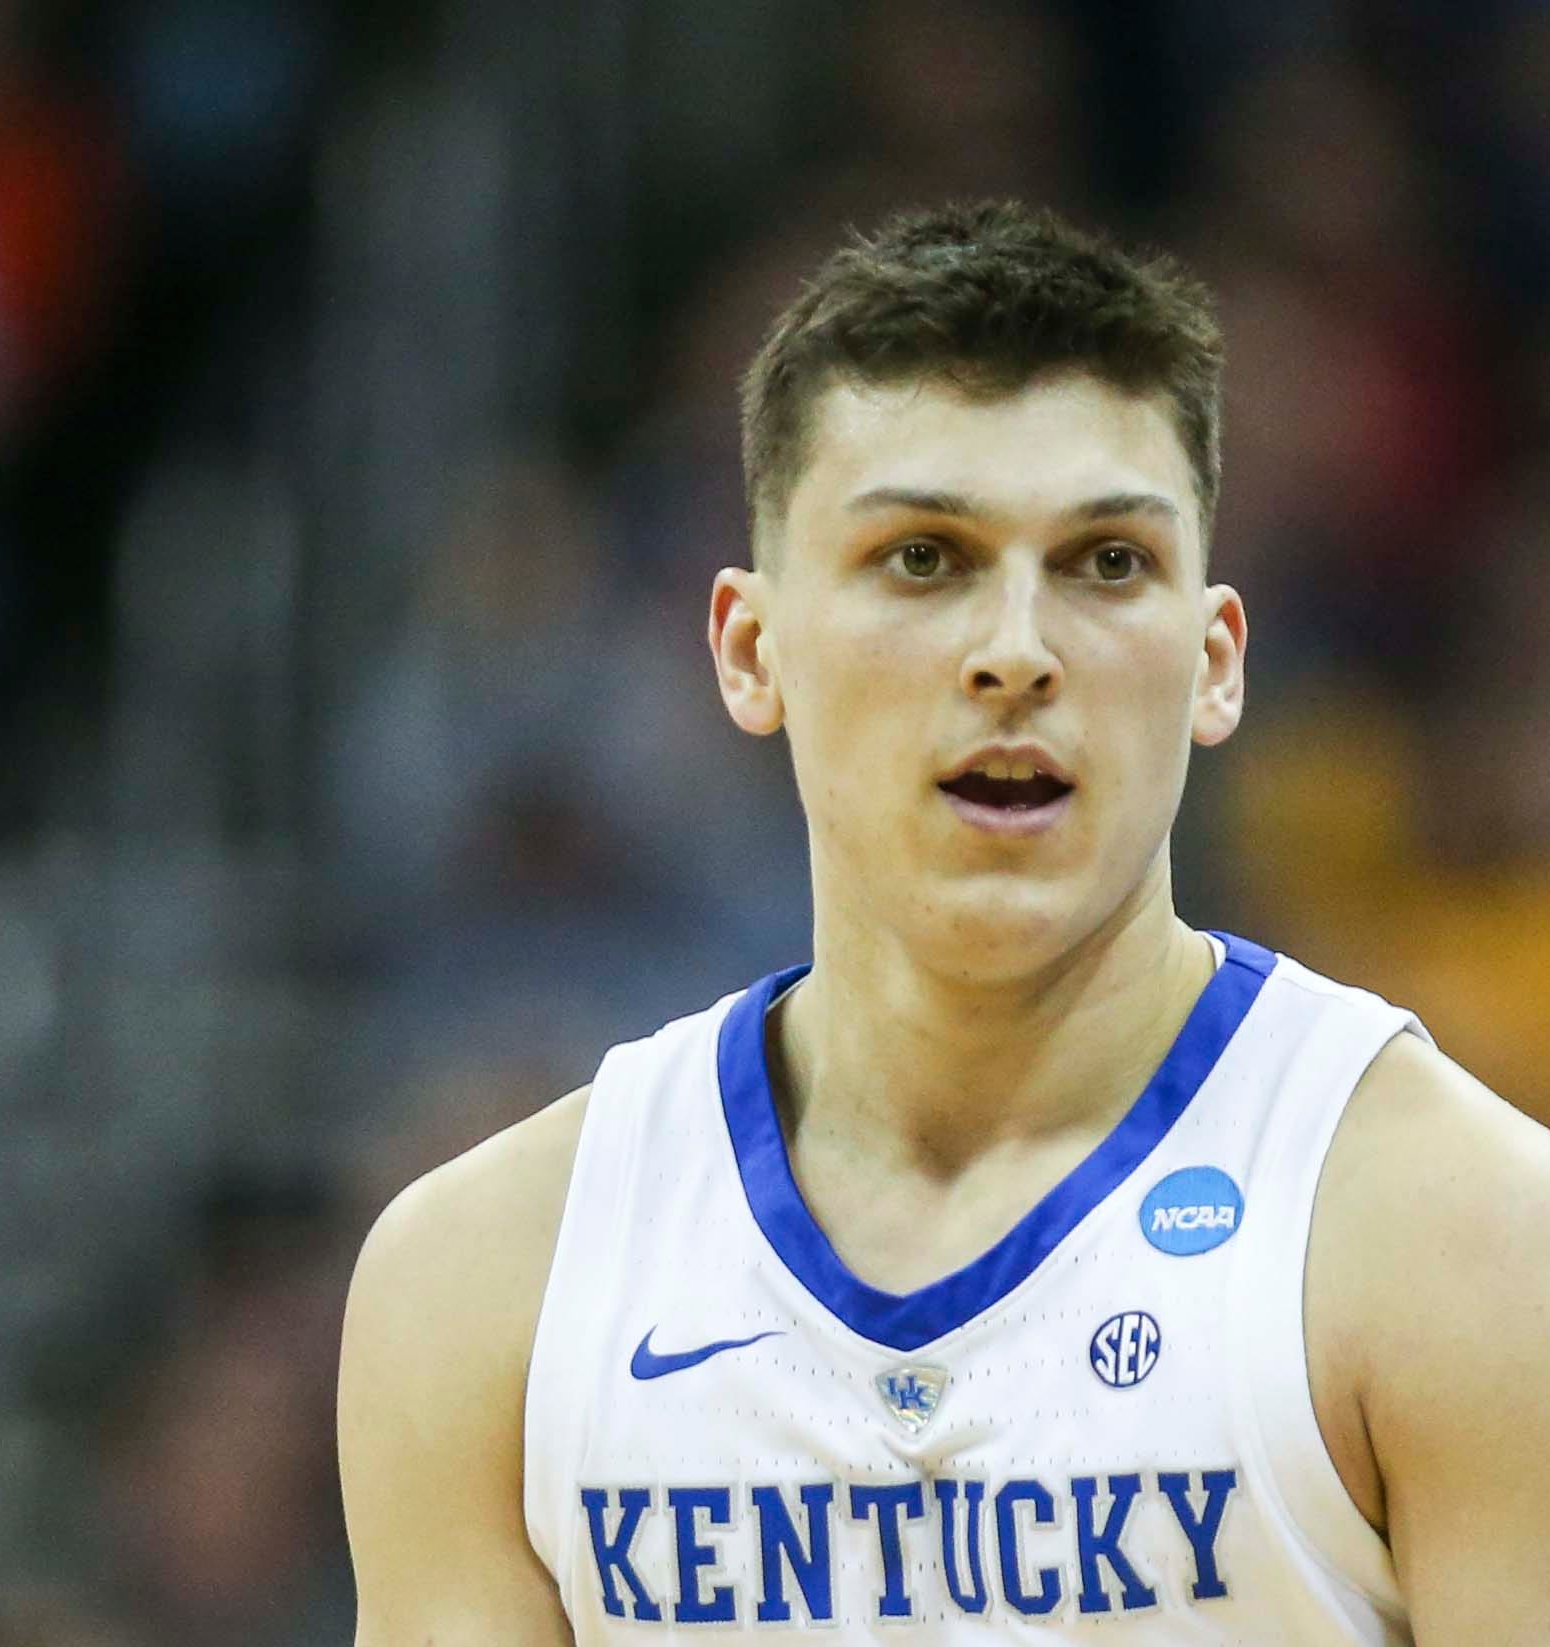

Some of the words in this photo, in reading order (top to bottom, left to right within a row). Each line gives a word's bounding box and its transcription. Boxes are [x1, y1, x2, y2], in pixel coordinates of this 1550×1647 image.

[1151, 1205, 1235, 1232] NCAA
[1094, 1314, 1158, 1384] SEC
[580, 1468, 1237, 1622] KENTUCKY
